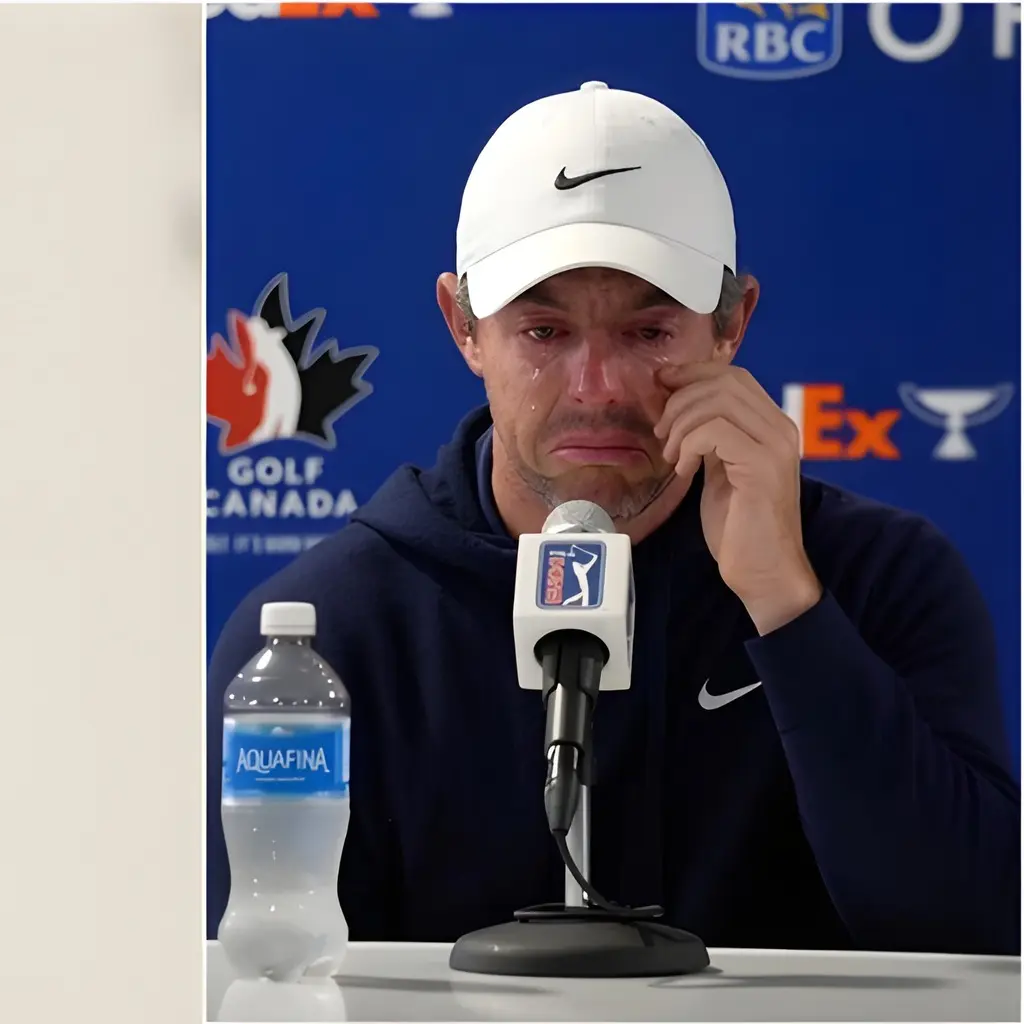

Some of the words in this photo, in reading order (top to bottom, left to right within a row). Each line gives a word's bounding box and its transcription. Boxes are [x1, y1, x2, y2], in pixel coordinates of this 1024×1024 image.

[715, 21, 826, 63] RBC
[783, 382, 901, 460] Ex
[227, 456, 324, 486] GOLF
[236, 747, 330, 774] AQUAFINA
